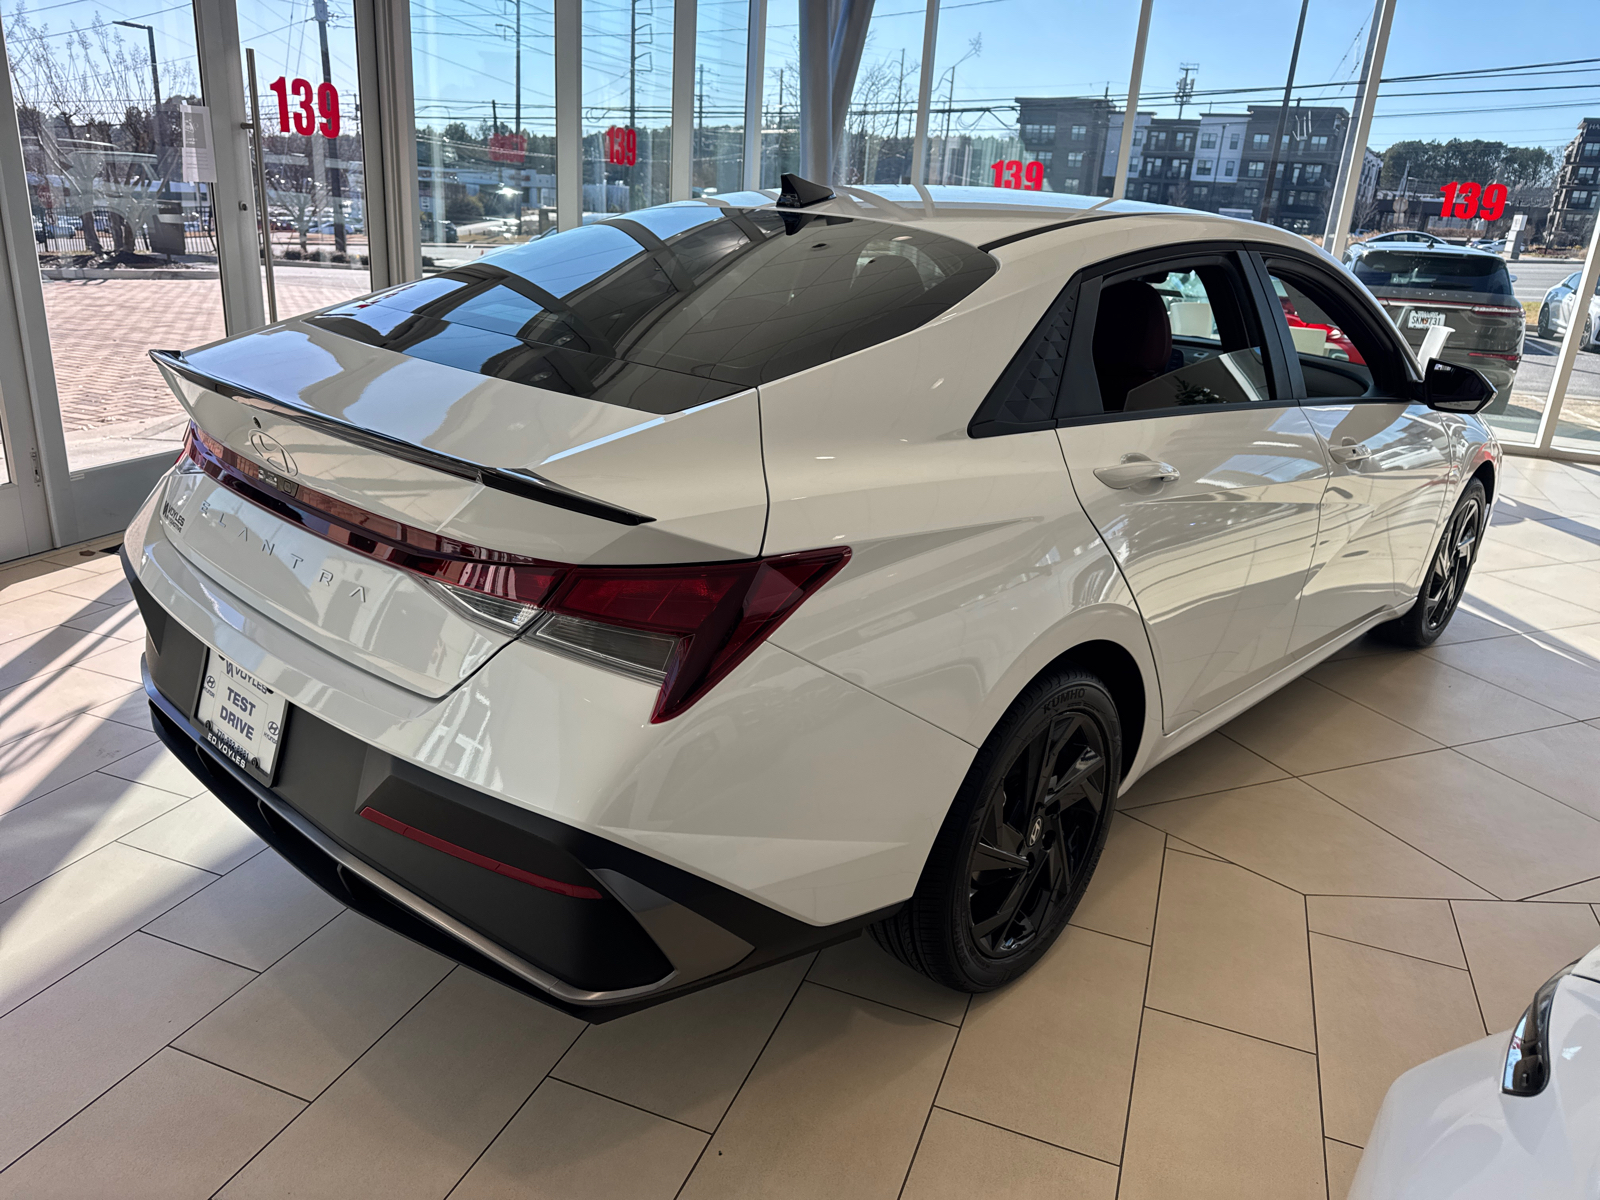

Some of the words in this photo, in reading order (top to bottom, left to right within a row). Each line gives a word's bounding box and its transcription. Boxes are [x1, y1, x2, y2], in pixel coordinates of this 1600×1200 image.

[269, 76, 340, 139] 139
[606, 126, 637, 166] 139
[991, 159, 1045, 191] 139
[1440, 181, 1508, 221] 139
[201, 500, 357, 603] ELANTRA
[227, 686, 257, 717] TEST
[1043, 687, 1087, 715] KUMHO
[219, 705, 255, 741] DRIVE
[207, 732, 217, 746] ED
[218, 741, 247, 769] VOYLES
